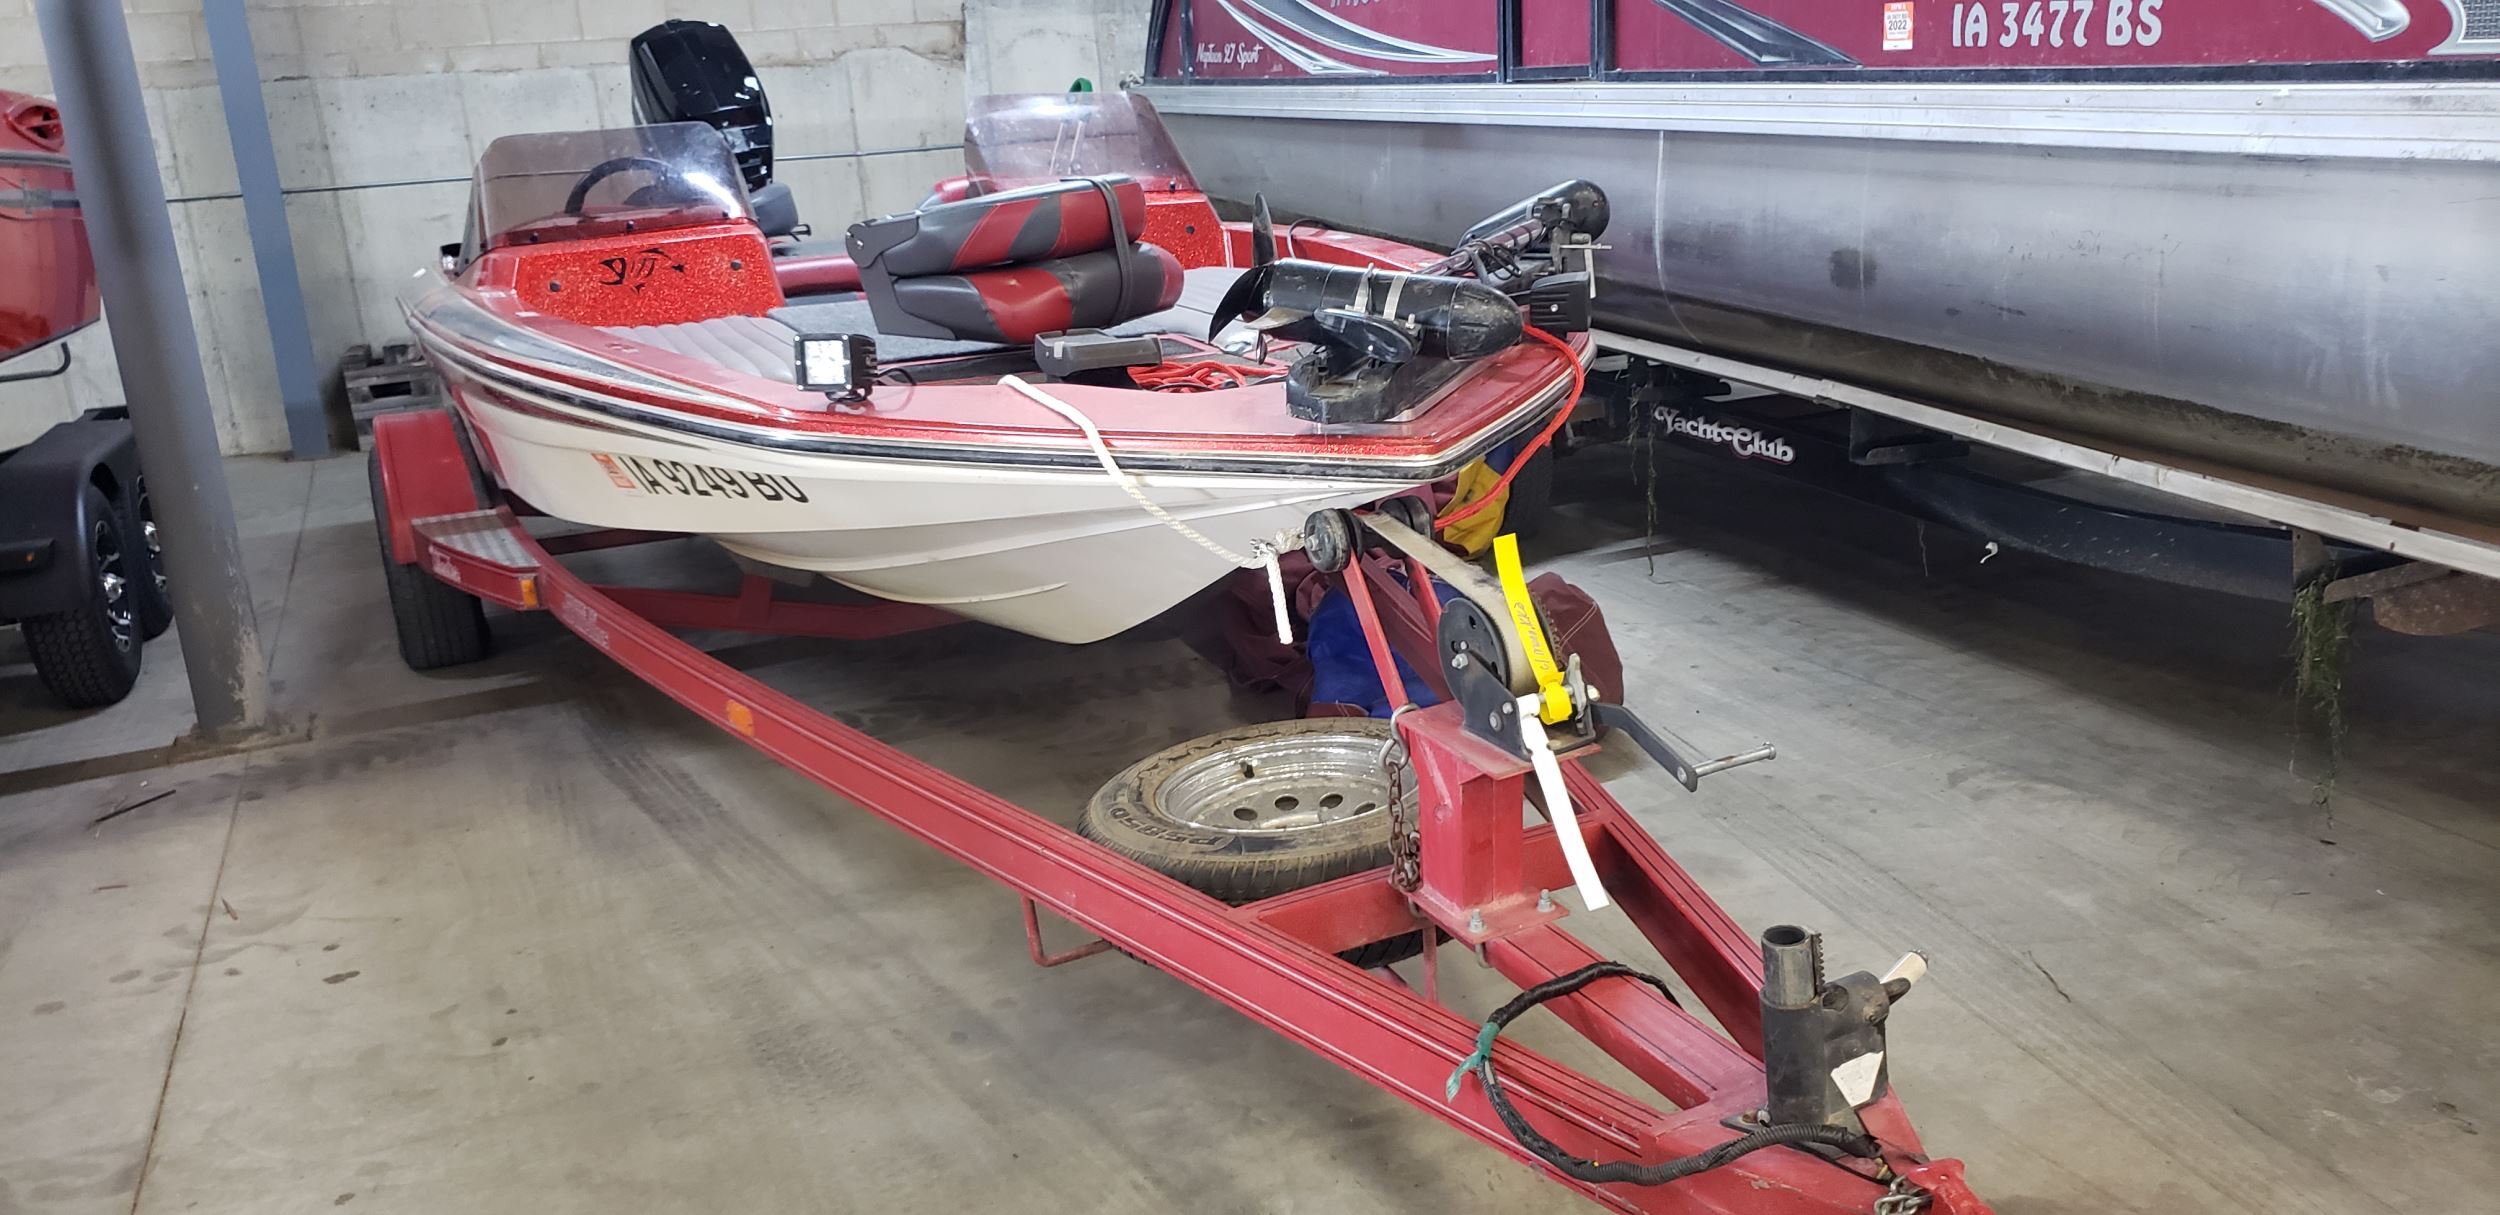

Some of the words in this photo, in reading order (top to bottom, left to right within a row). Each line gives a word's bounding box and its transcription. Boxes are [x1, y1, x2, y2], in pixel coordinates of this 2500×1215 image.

[1888, 19, 1907, 31] 2022
[1952, 1, 1988, 48] IA
[1999, 0, 2093, 48] 3477
[2105, 0, 2164, 47] BS
[1236, 42, 1264, 70] Sport
[618, 456, 672, 495] IA
[652, 458, 750, 499] 9249
